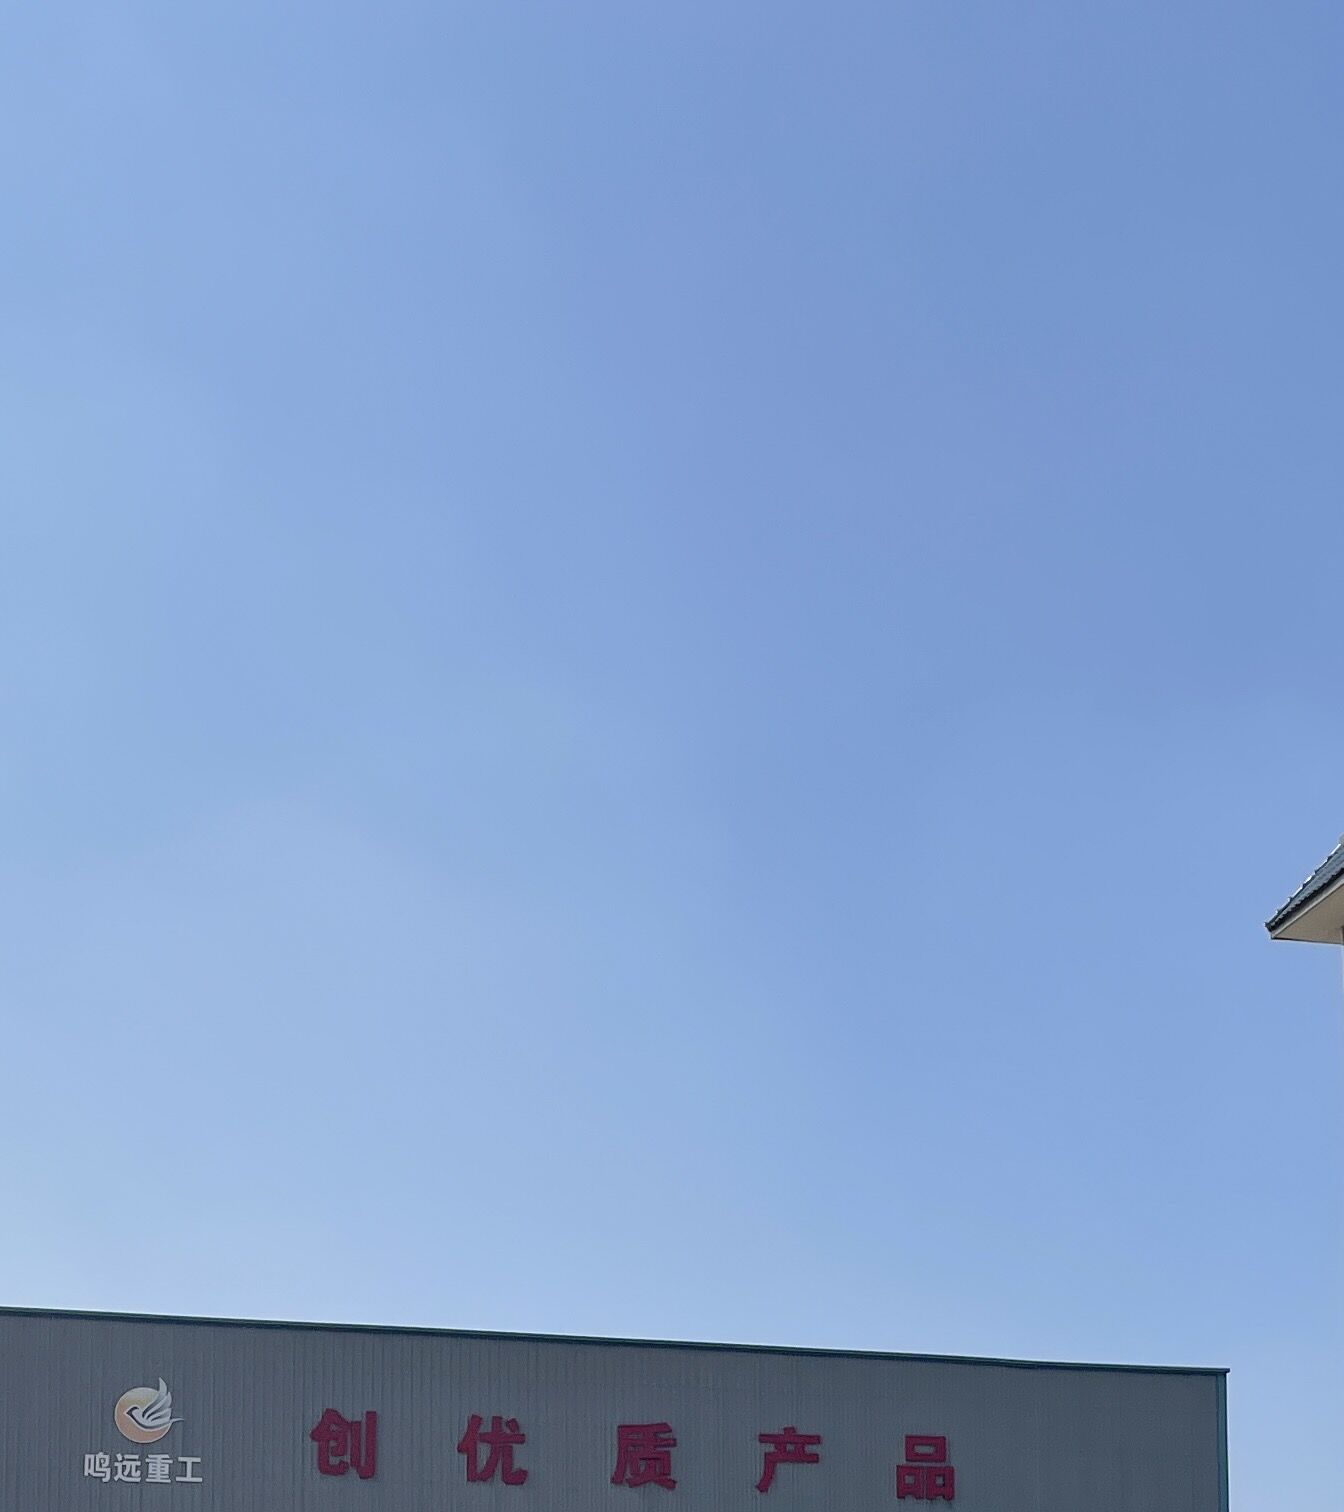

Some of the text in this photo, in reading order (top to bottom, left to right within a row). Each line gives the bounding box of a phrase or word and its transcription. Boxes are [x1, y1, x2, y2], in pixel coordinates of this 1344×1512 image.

[83, 1452, 203, 1483] 鸣远重工
[309, 1407, 957, 1501] 创优质产品
